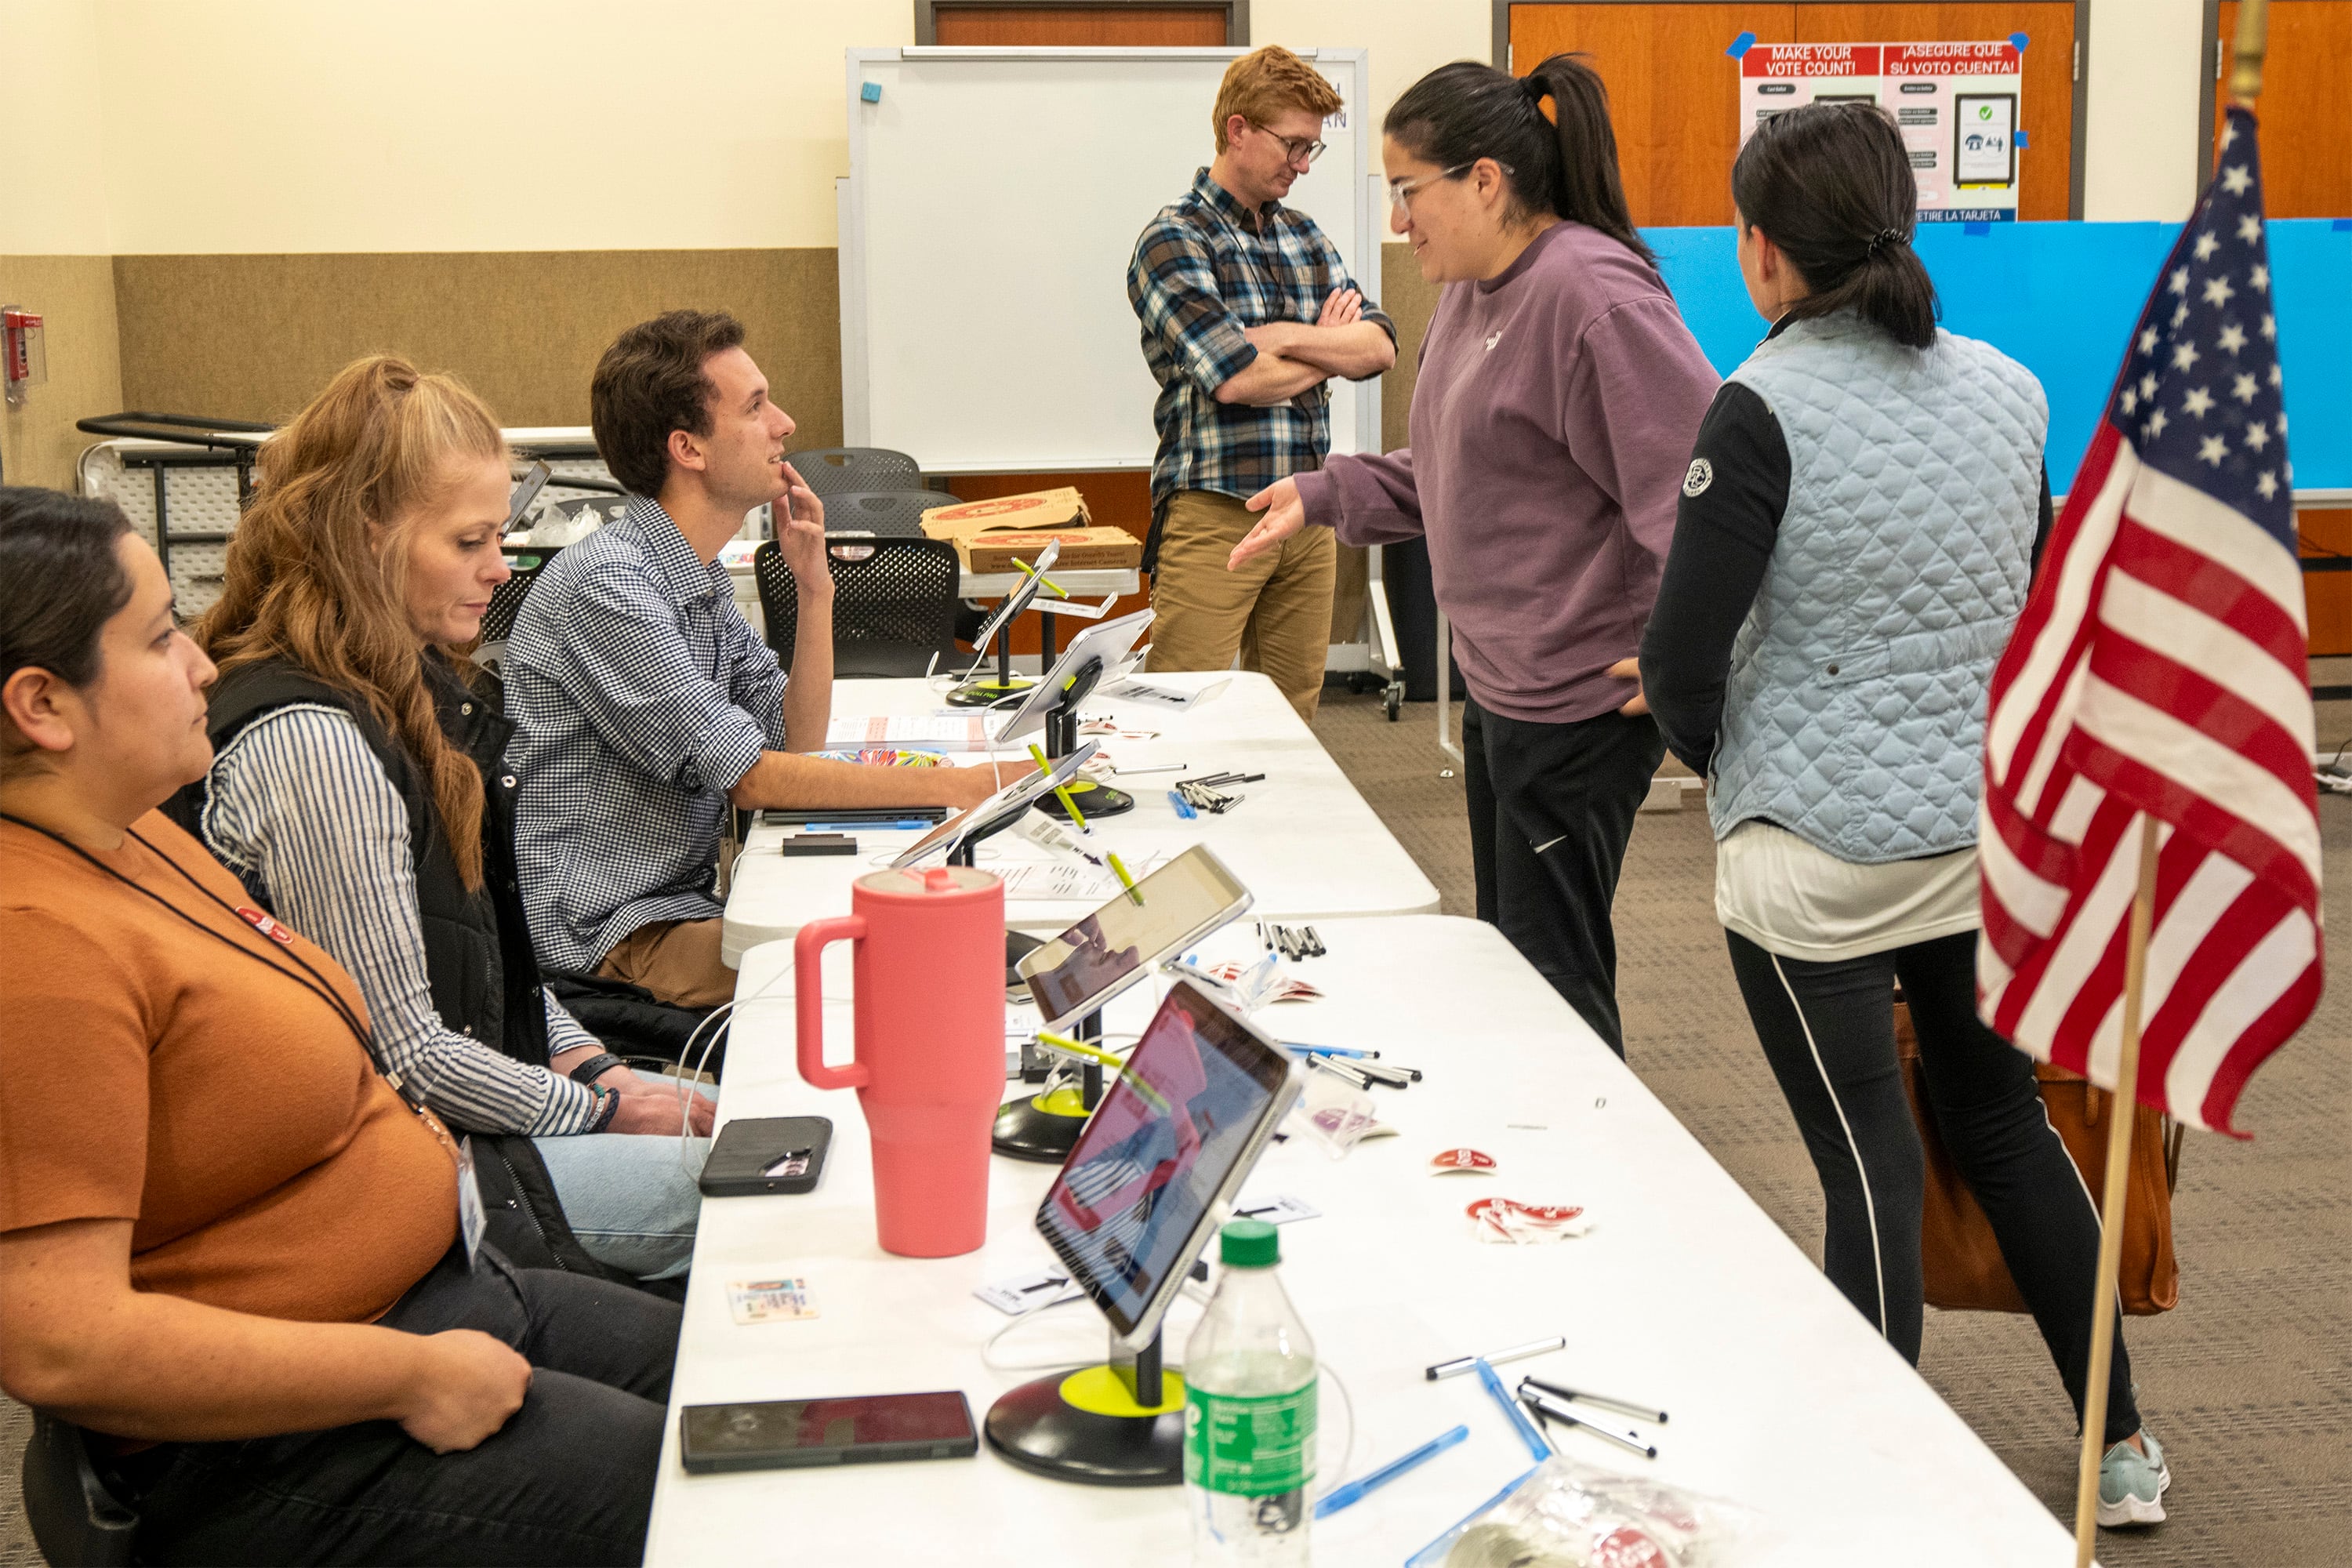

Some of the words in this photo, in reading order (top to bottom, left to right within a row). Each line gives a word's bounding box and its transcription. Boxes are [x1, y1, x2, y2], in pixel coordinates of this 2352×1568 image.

[1772, 46, 1811, 60] MAKE
[1814, 46, 1852, 60] YOUR
[1903, 45, 1971, 59] ¡ASEGURE
[1974, 45, 2003, 57] QUE
[1766, 61, 1802, 76] VOTE
[1805, 60, 1856, 75] COUNT!
[1890, 62, 1909, 74] SU
[1913, 62, 1951, 74] VOTO
[1955, 61, 2014, 74] CUENTA!
[1916, 210, 1944, 222] ETIRE
[1945, 210, 1958, 221] LA
[1960, 209, 2001, 221] TARJETA
